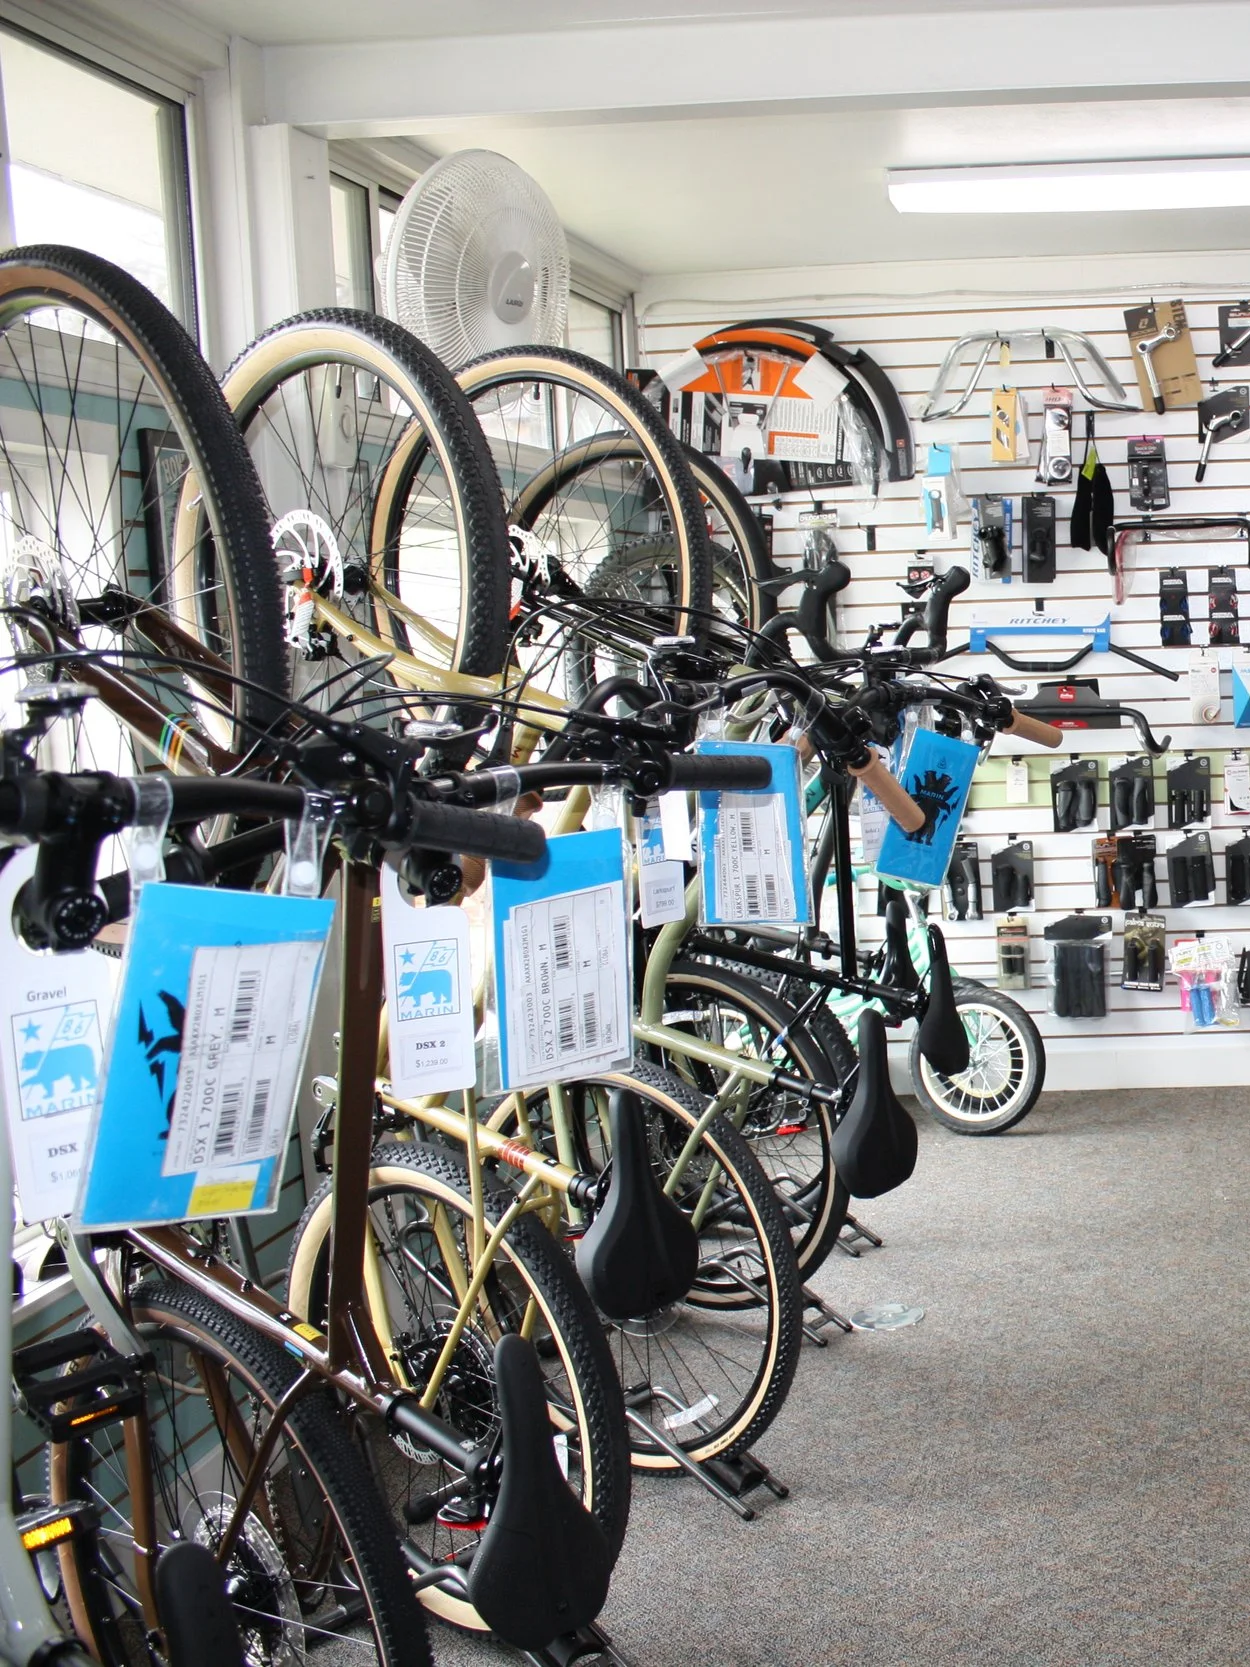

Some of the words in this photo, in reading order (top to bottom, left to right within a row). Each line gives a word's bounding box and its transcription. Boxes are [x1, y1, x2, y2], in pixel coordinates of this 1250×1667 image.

[920, 789, 945, 800] MARIN
[732, 853, 740, 872] 700C
[734, 883, 743, 918] LARKSPUR
[538, 943, 547, 951] M
[430, 950, 446, 962] 86
[583, 959, 591, 968] M
[27, 987, 67, 1002] Gravel
[401, 1005, 454, 1019] MARIN
[526, 992, 536, 1037] 732423003
[543, 999, 552, 1025] 700C
[61, 1017, 84, 1036] 86
[266, 1034, 277, 1045] M
[416, 1041, 436, 1050] DSX
[440, 1040, 446, 1048] 2
[545, 1038, 554, 1060] DSX
[193, 1138, 208, 1164] DSX
[201, 1078, 216, 1113] 700C
[214, 1007, 226, 1018] M
[25, 1092, 97, 1119] MARIN
[47, 1142, 78, 1158] DSX
